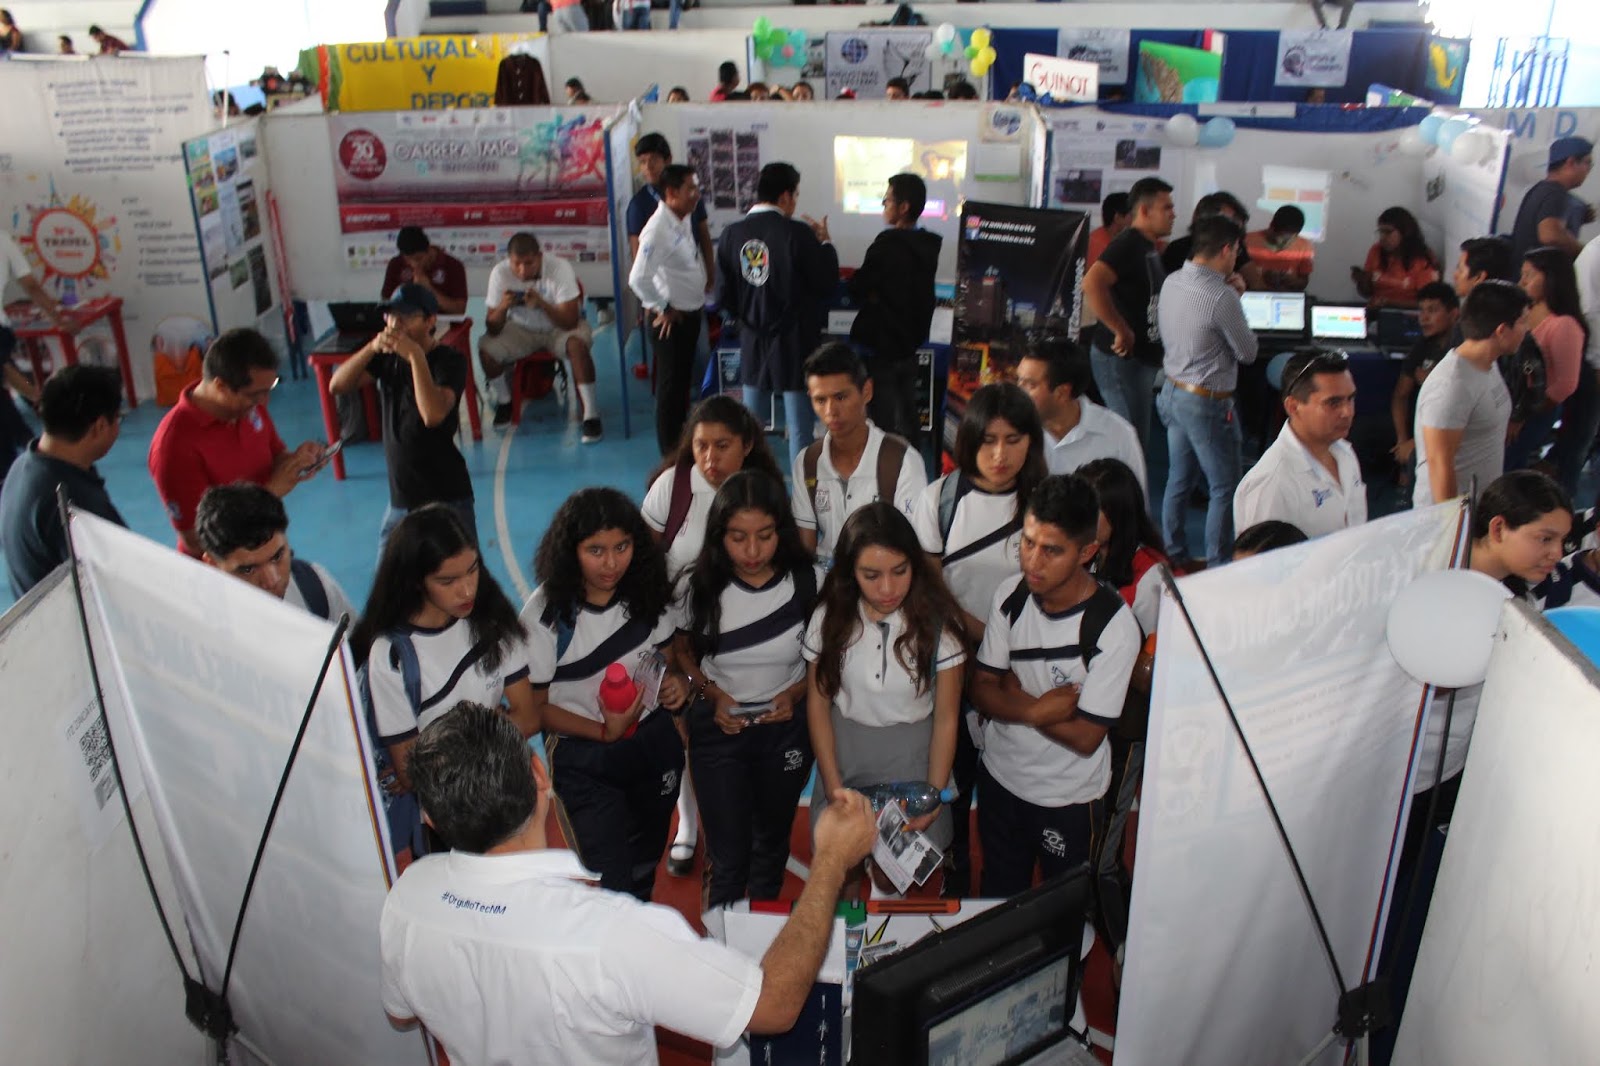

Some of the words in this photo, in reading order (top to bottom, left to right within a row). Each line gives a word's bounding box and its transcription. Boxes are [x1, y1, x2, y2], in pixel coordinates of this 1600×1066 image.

[347, 39, 476, 63] CULTURAL
[422, 65, 436, 84] Y
[1030, 62, 1088, 96] GUINOT
[1555, 111, 1578, 138] D
[395, 141, 470, 161] CARRERA
[441, 891, 507, 915] #OrgulloTecNM
